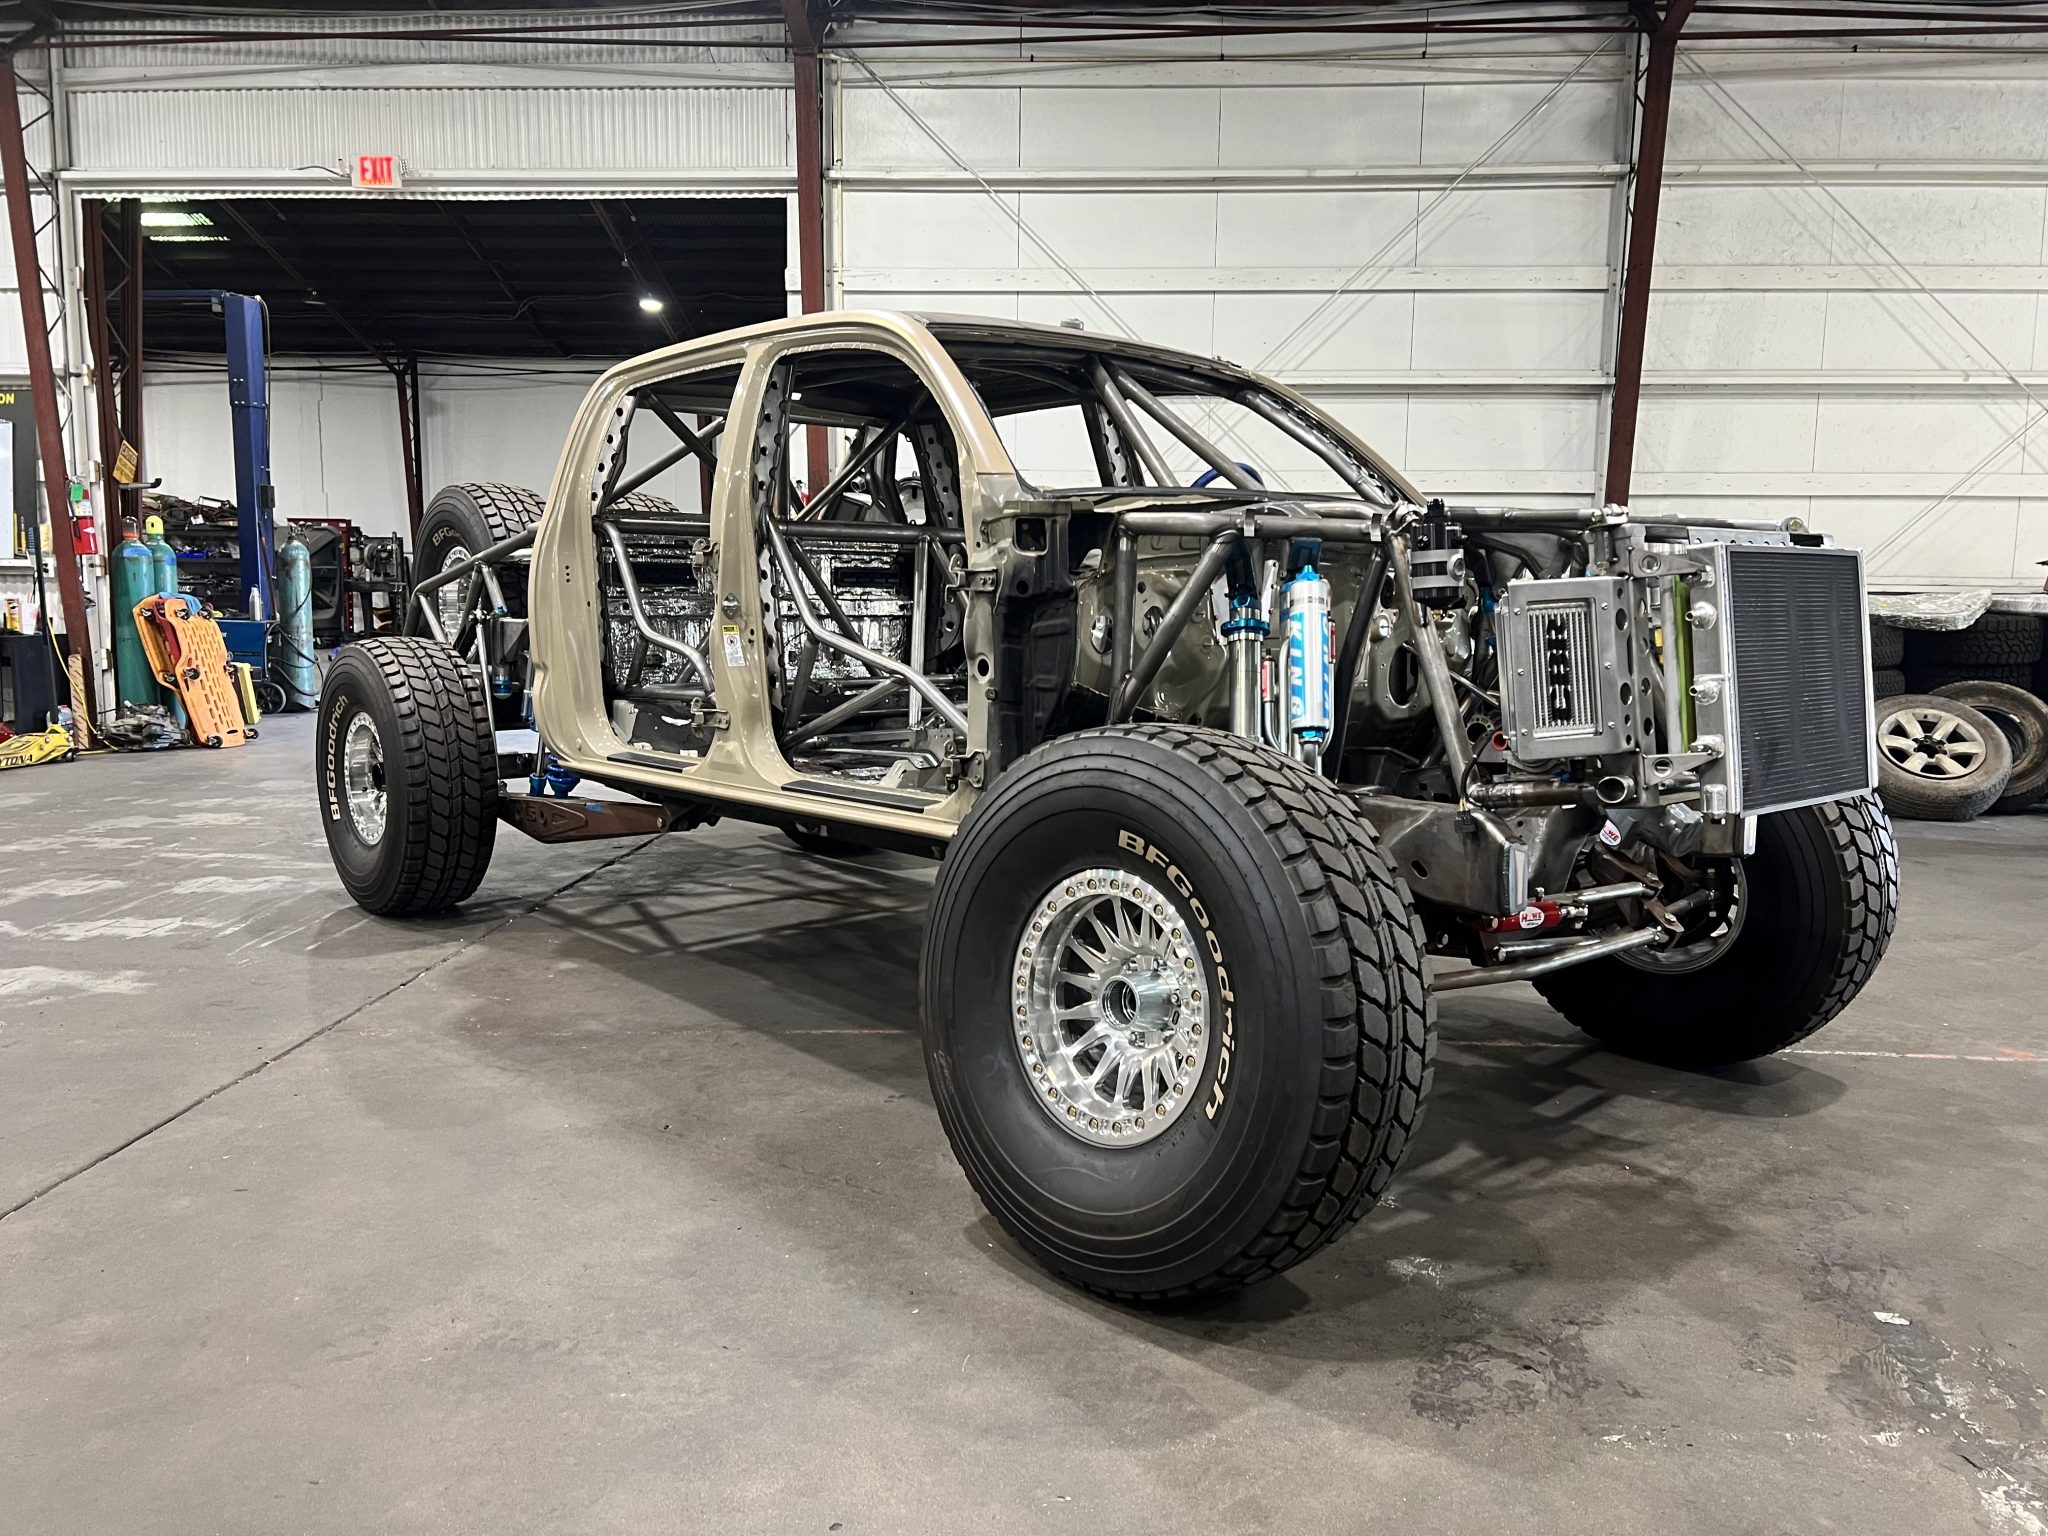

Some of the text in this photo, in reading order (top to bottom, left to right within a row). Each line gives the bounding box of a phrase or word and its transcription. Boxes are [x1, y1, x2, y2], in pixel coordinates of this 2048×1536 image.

[360, 156, 392, 184] EXIT
[1290, 619, 1303, 719] KING
[0, 754, 33, 767] TONA
[327, 694, 349, 821] BFGoodrich
[1118, 829, 1235, 1121] BFGoodrich
